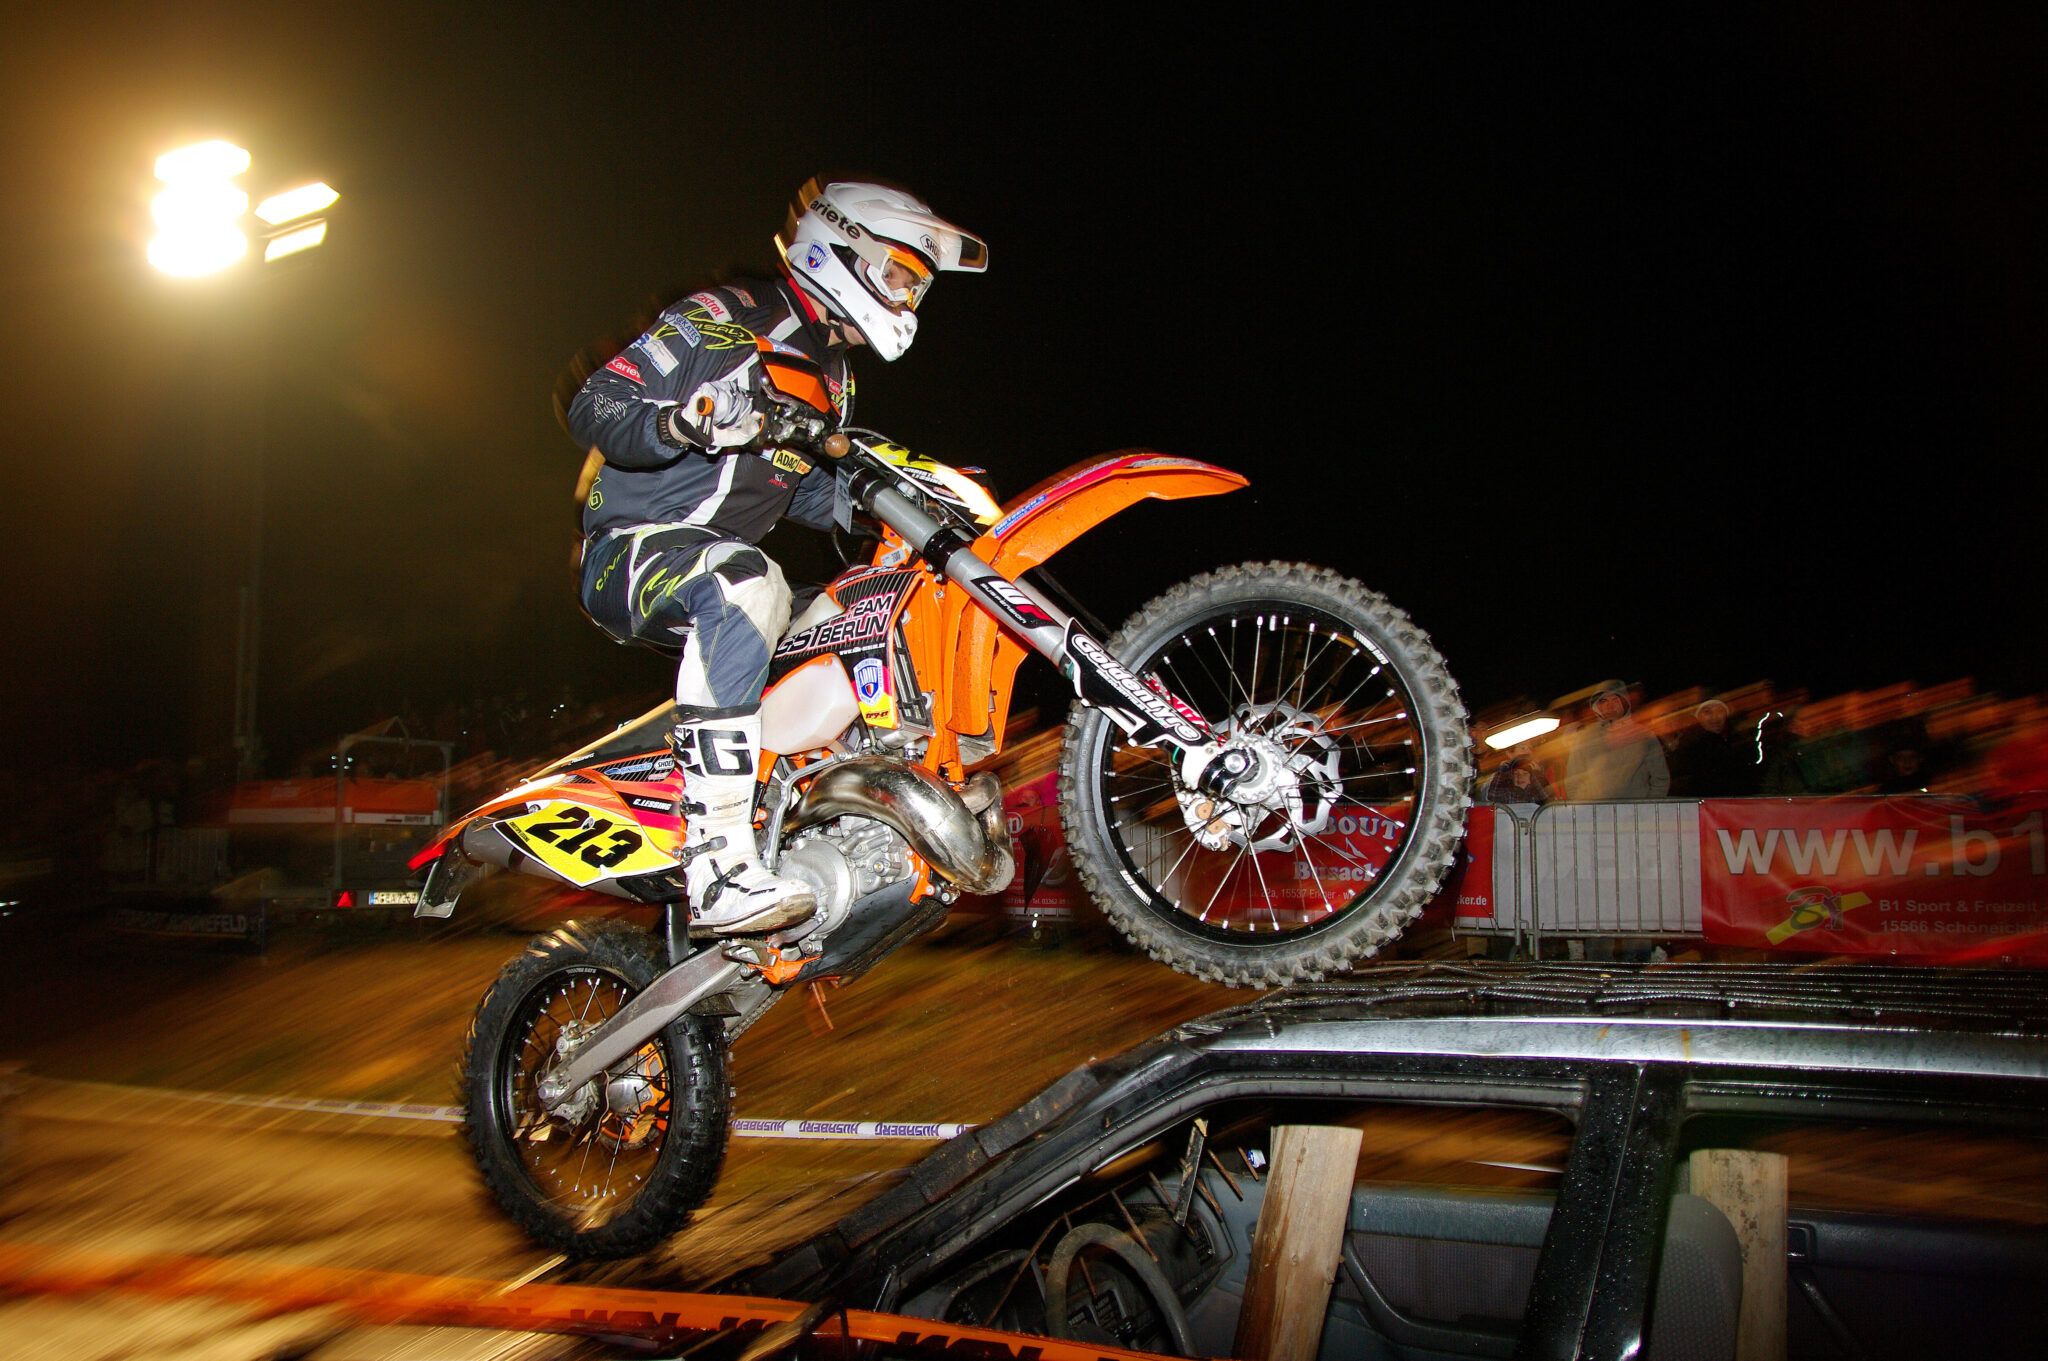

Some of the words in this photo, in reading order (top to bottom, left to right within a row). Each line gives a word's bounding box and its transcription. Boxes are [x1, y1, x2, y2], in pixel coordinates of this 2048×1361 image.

[810, 199, 861, 240] ariete
[775, 452, 799, 471] ADAC
[525, 806, 643, 869] 213
[1716, 811, 2046, 877] www.b1
[1457, 895, 1487, 906] ker.de
[1879, 899, 1899, 913] B1
[1905, 899, 1949, 914] Sport
[1956, 899, 1969, 913] &
[1880, 920, 1930, 933] 15566
[798, 1121, 861, 1135] HUSABERG
[874, 1122, 942, 1137] HUSABERG
